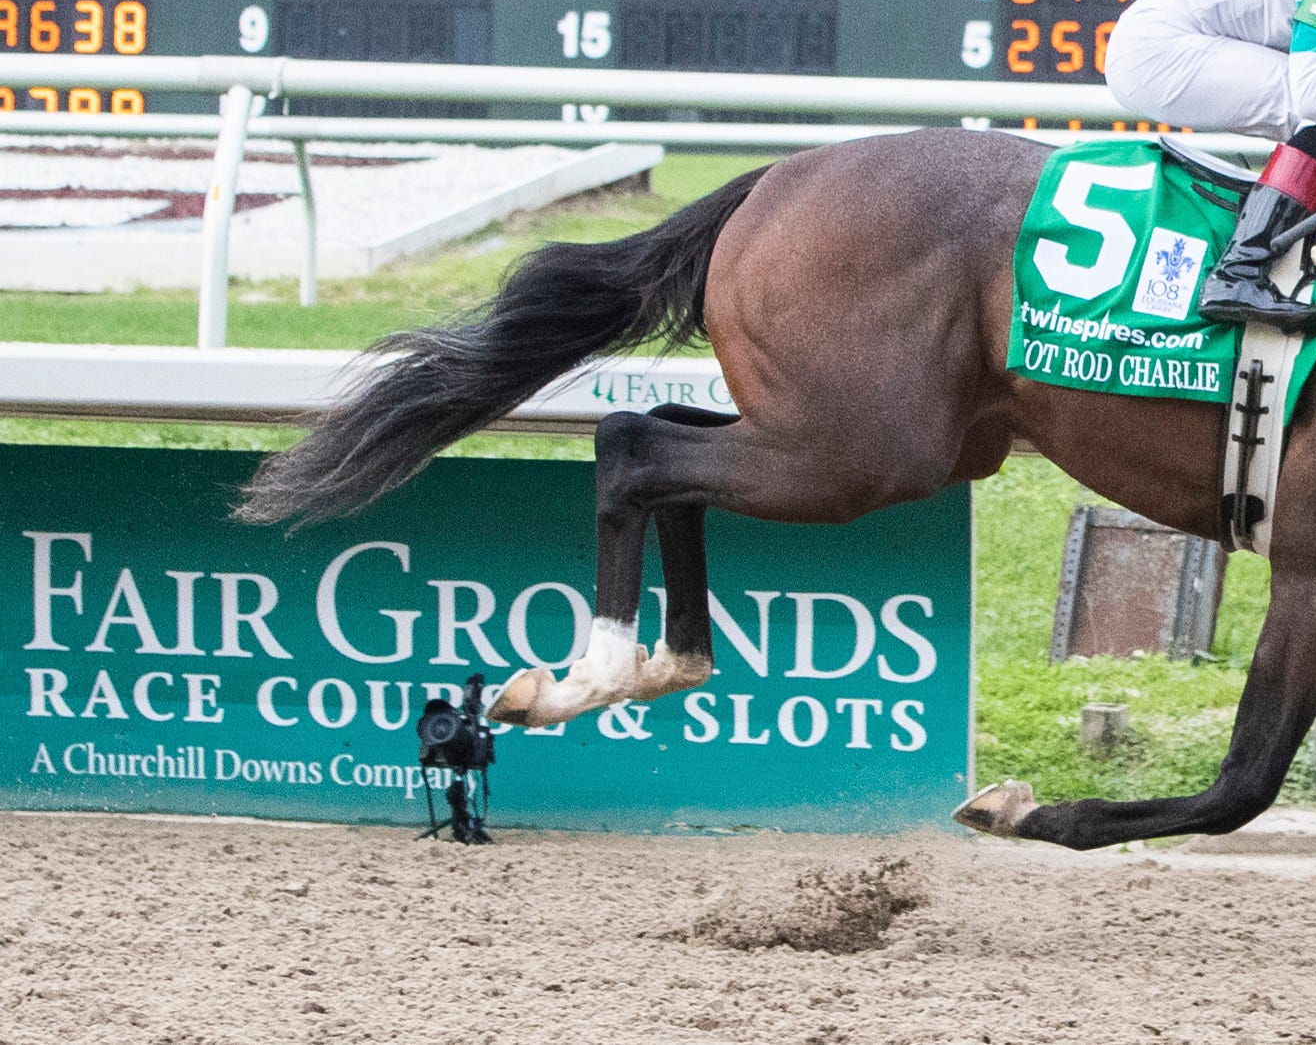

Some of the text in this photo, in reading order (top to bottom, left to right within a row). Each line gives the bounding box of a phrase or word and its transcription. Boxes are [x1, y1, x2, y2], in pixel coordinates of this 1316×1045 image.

[239, 6, 270, 53] 9
[557, 11, 611, 59] 15
[961, 21, 993, 68] 5
[1033, 160, 1157, 300] 5
[1021, 299, 1204, 350] twinspires.com
[1024, 339, 1220, 392] OT ROD CHARLIE
[22, 530, 938, 684] FAIR GRONDS
[24, 668, 226, 723] RACE
[597, 699, 653, 740] &
[684, 692, 928, 752] SLOTS
[31, 743, 55, 774] A
[63, 742, 205, 780] Churchill
[216, 749, 323, 785] Downs
